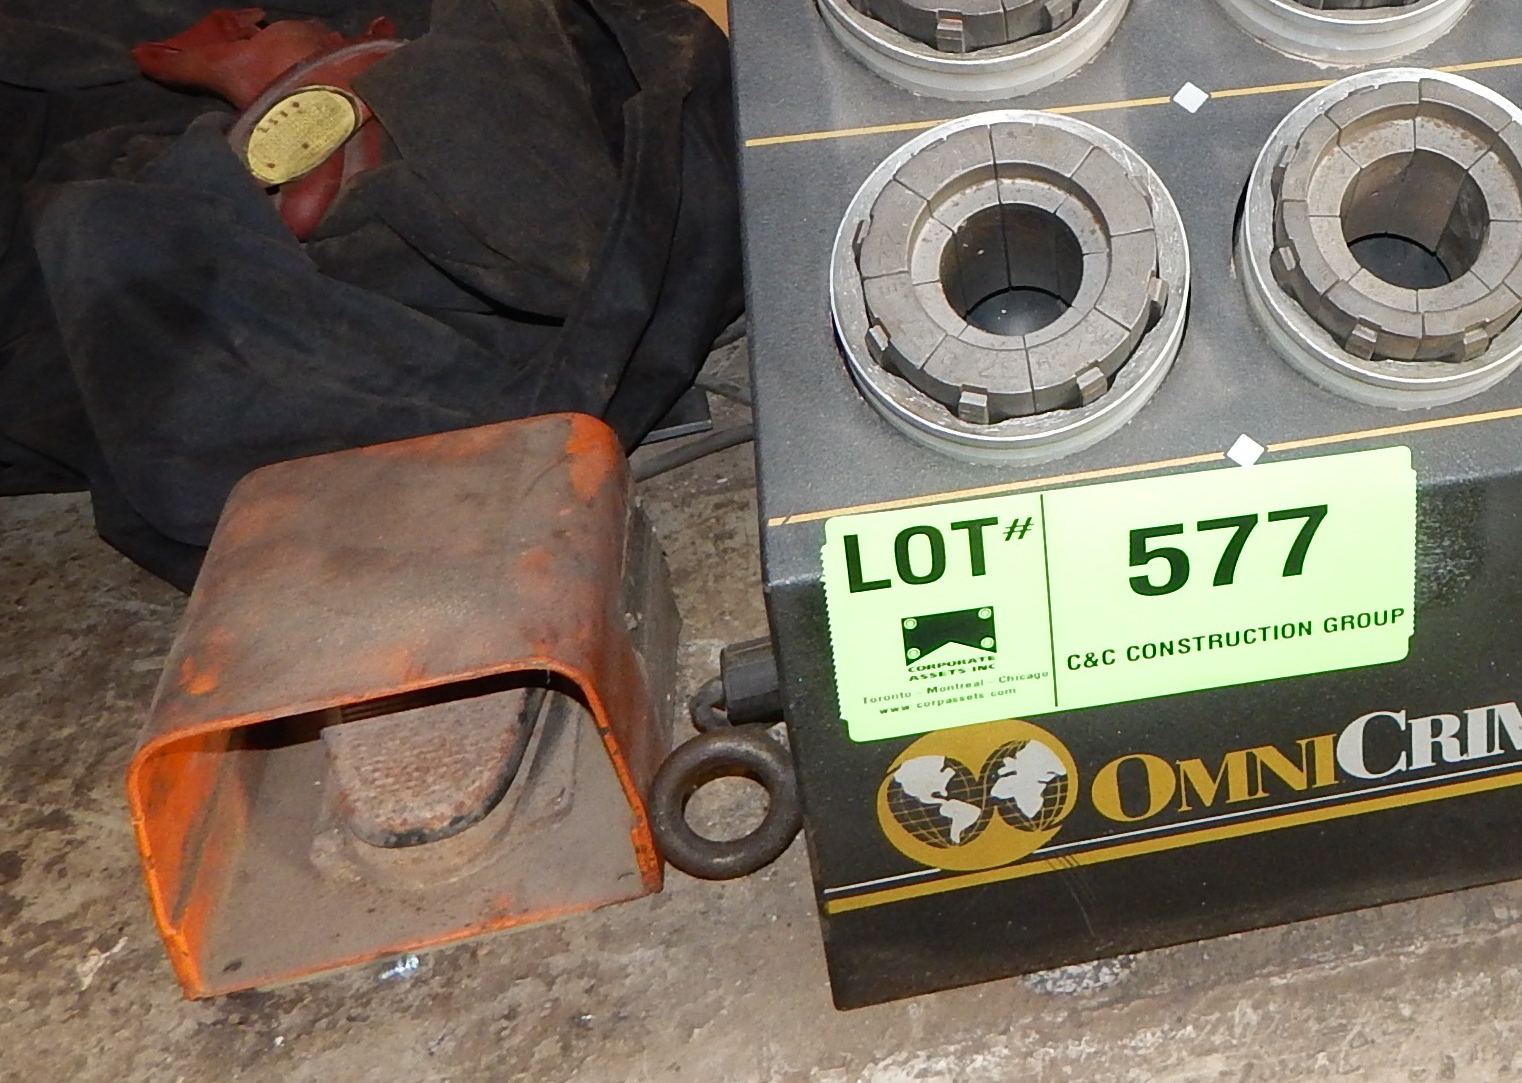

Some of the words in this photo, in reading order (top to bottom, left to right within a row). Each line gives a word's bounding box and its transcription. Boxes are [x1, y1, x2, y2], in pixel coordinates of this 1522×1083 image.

[1129, 504, 1328, 596] 577
[1067, 649, 1116, 670] C&C
[1126, 620, 1313, 662] CONSTRUCTION
[1323, 608, 1405, 633] GROUP
[908, 655, 996, 673] CORPORATE
[909, 668, 967, 682] ASSETS
[972, 663, 996, 672] INC
[863, 692, 912, 705] Toronto
[927, 679, 983, 694] Montreal
[998, 671, 1049, 684] Chicago
